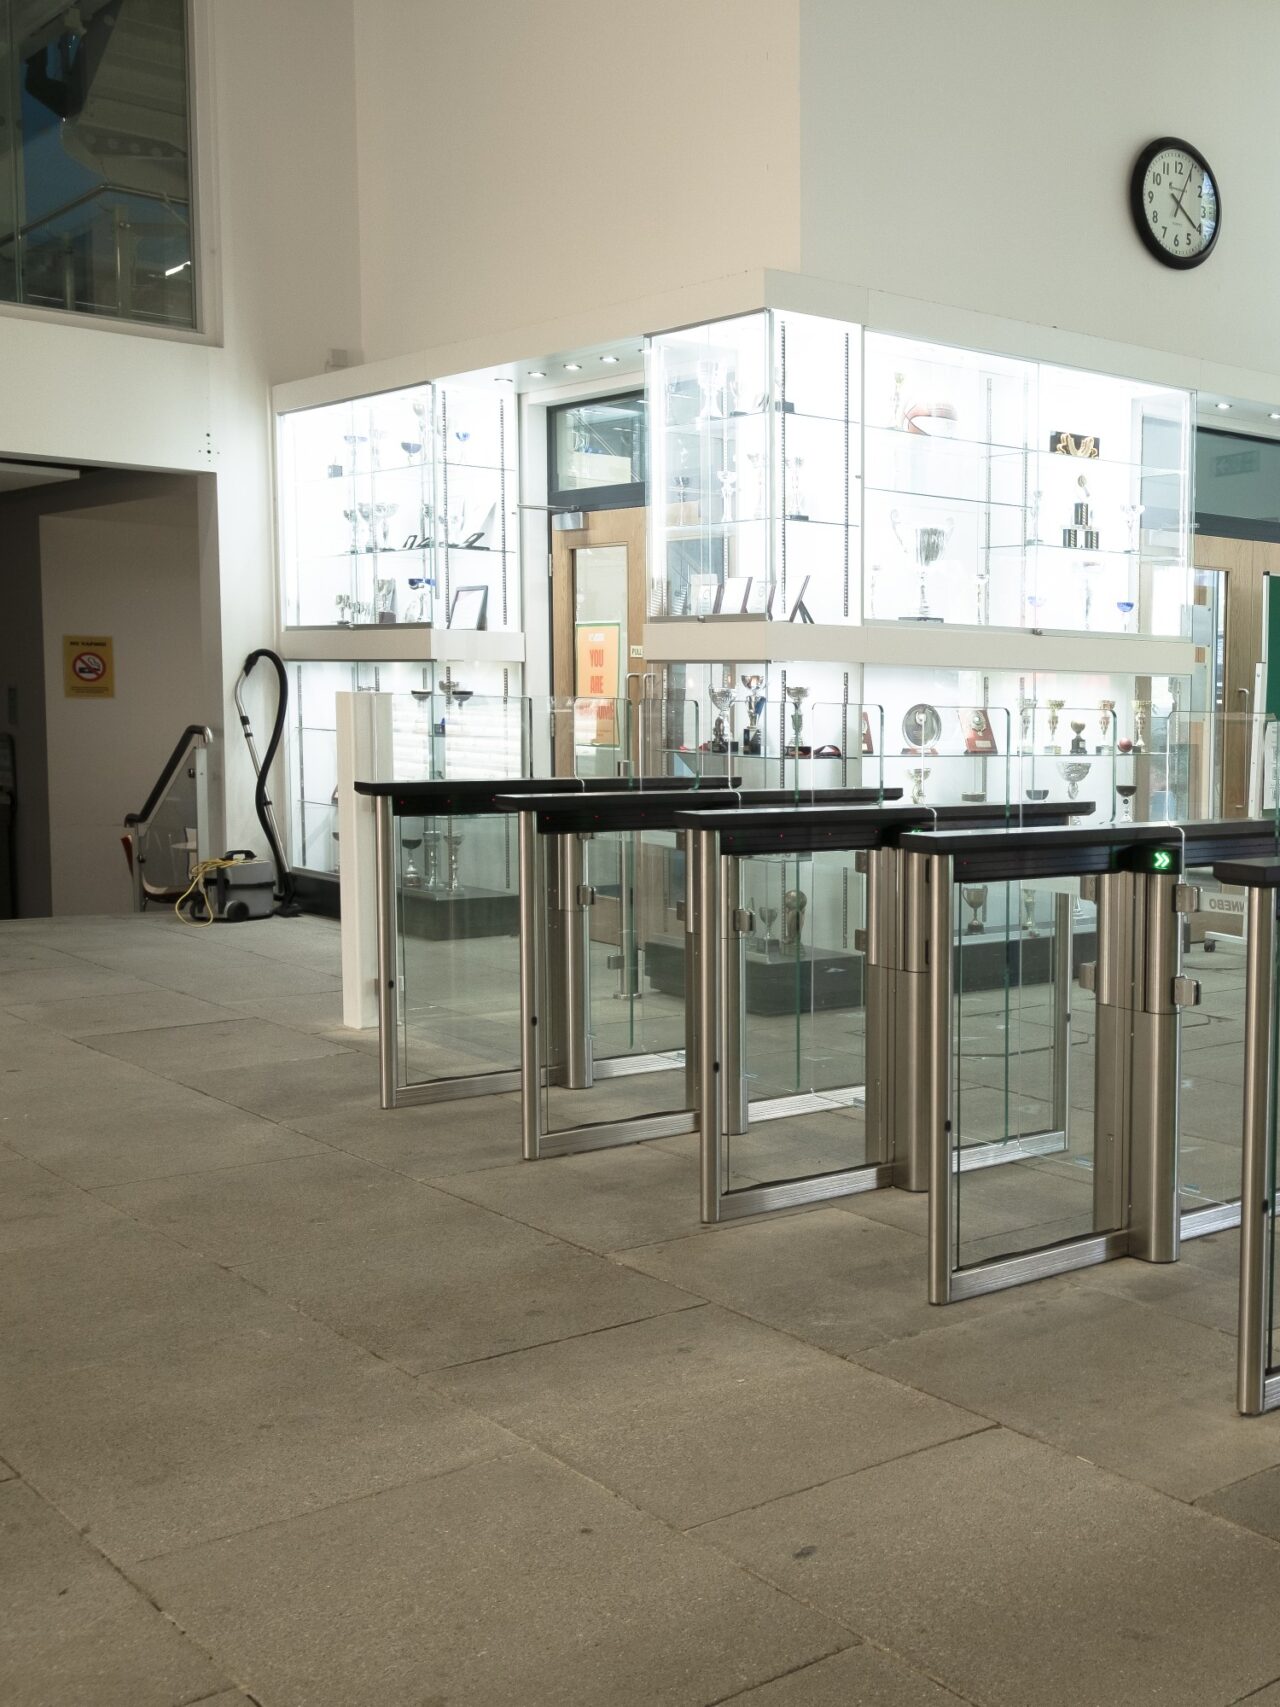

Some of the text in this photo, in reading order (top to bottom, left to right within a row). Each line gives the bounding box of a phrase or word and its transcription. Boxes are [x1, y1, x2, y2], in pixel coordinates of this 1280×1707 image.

[1162, 161, 1170, 175] 11
[1174, 161, 1184, 175] 12
[1152, 172, 1162, 186] 10
[1148, 191, 1154, 204] 9
[1197, 185, 1203, 199] 2
[1152, 211, 1158, 224] 8
[1200, 206, 1207, 219] 3
[1161, 226, 1168, 239] 7
[1196, 223, 1202, 236] 4
[1173, 234, 1180, 247] 6
[1186, 233, 1192, 246] 5
[589, 648, 604, 667] YOU
[590, 675, 604, 693] ARE
